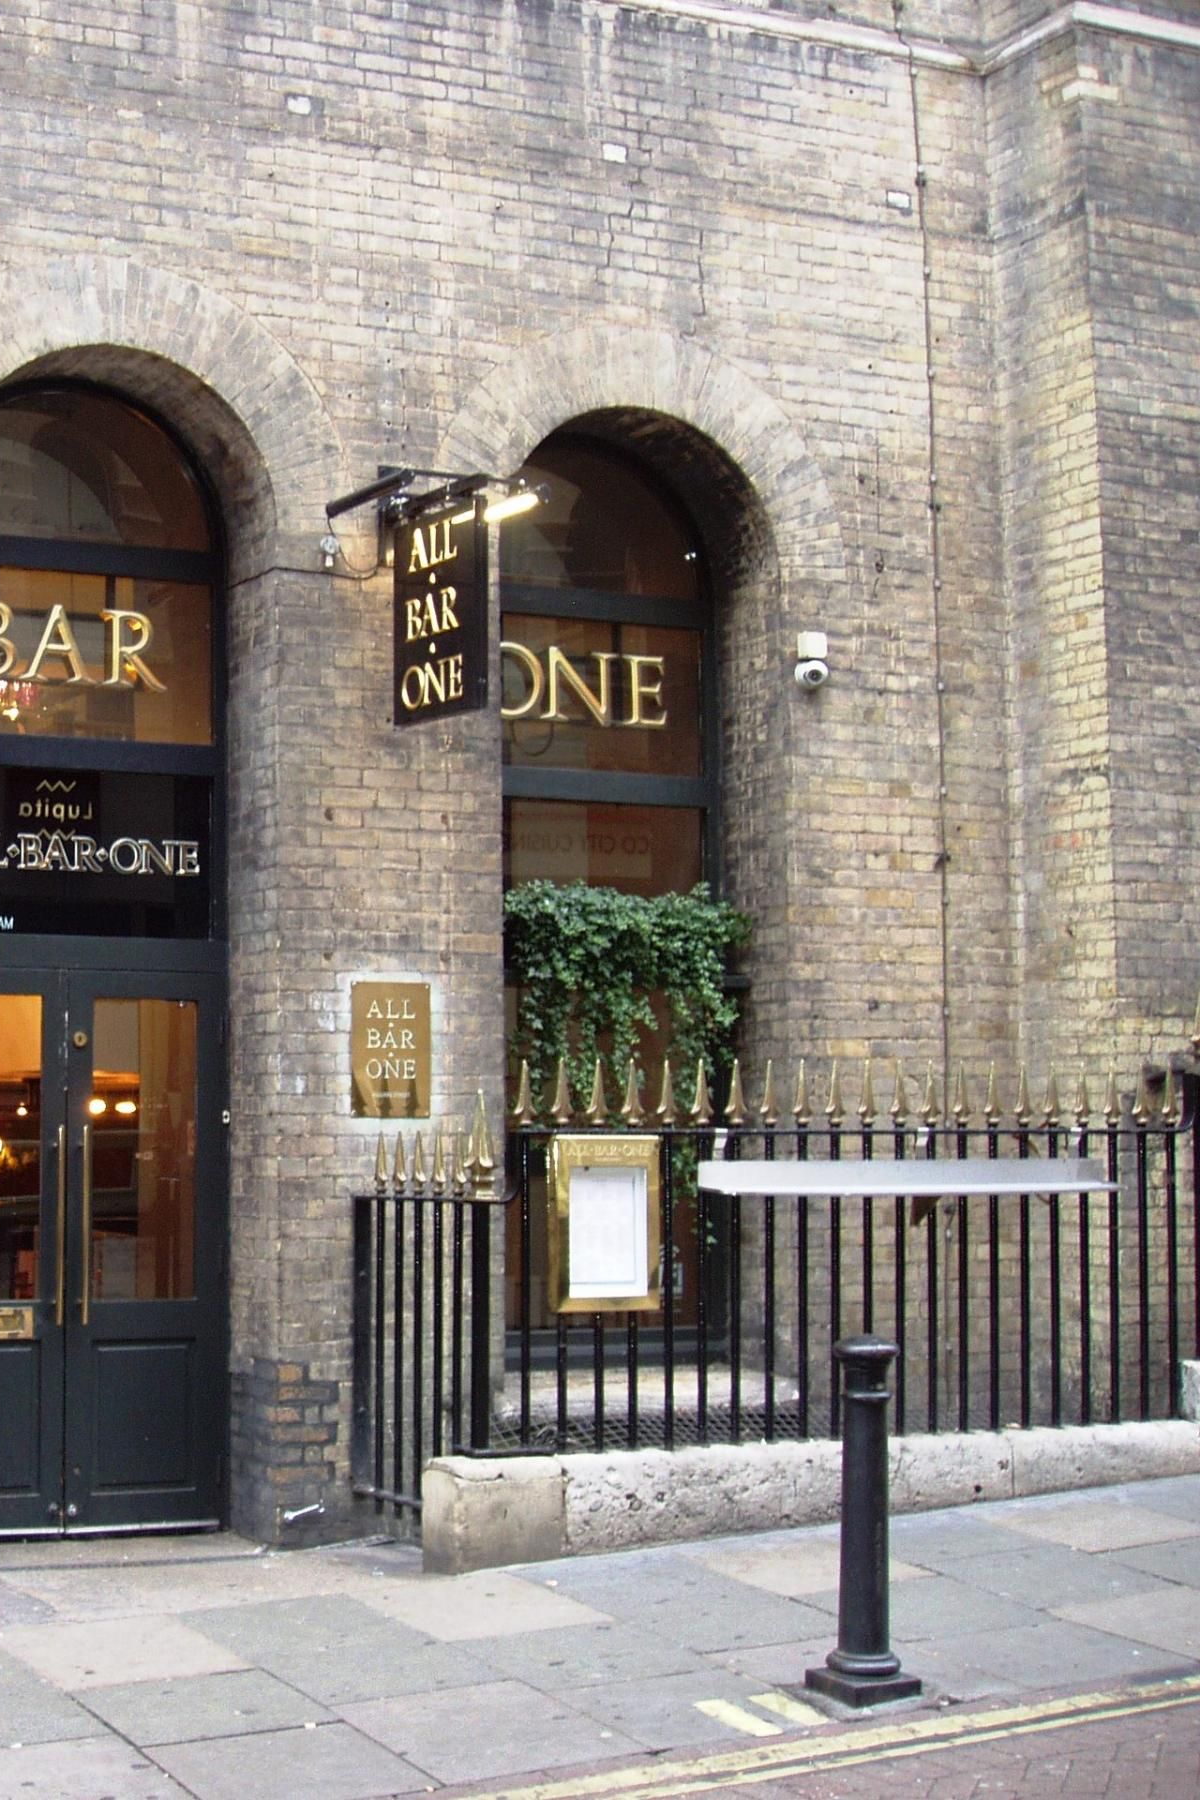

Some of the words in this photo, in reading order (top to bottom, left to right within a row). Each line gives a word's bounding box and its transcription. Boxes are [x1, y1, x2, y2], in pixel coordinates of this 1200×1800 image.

[408, 517, 458, 573] ALL
[405, 586, 460, 643] BAR
[401, 653, 464, 711] ONE
[500, 641, 668, 728] ONE
[366, 998, 416, 1020] ALL
[366, 1028, 416, 1049] BAR
[366, 1058, 416, 1080] ONE
